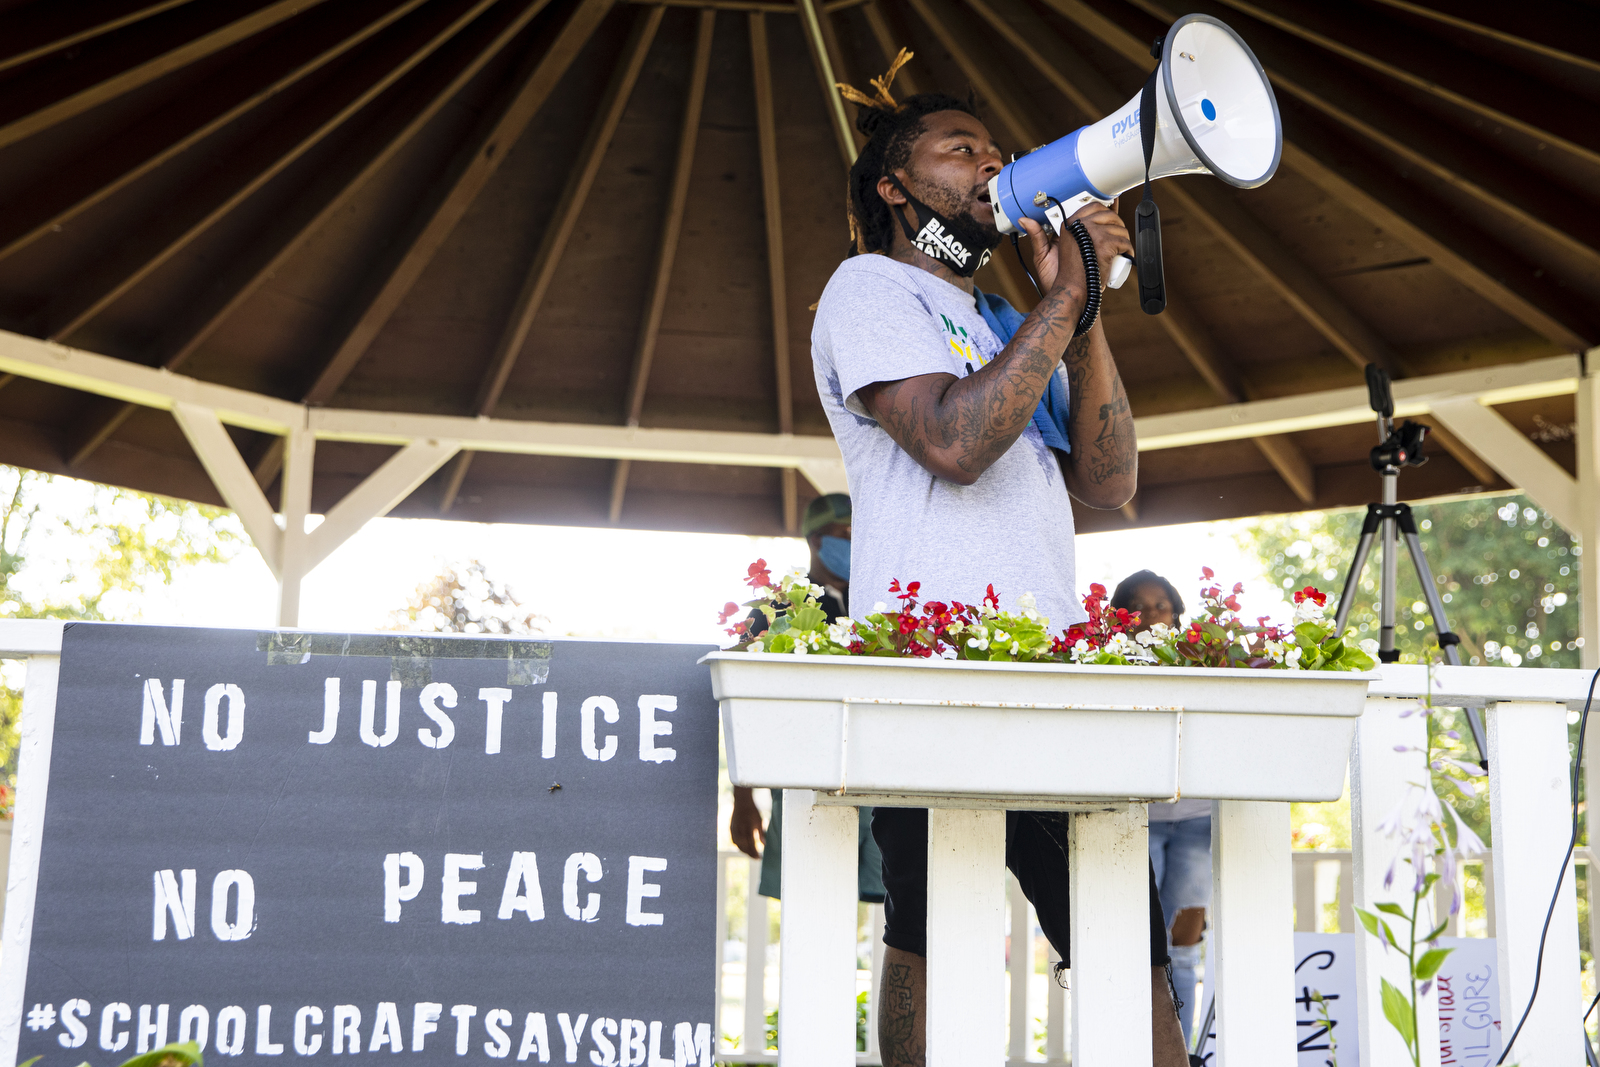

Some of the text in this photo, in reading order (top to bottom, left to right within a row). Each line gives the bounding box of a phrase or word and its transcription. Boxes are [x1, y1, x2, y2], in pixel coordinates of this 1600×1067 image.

[1111, 108, 1141, 139] PYLE
[1113, 128, 1141, 148] PyleUSA.co
[926, 217, 972, 265] BLACK
[140, 677, 677, 764] NO JUSTICE
[153, 851, 667, 941] NO PEACE
[26, 998, 711, 1067] #SCHOOLCRAFTSAYSBLM
